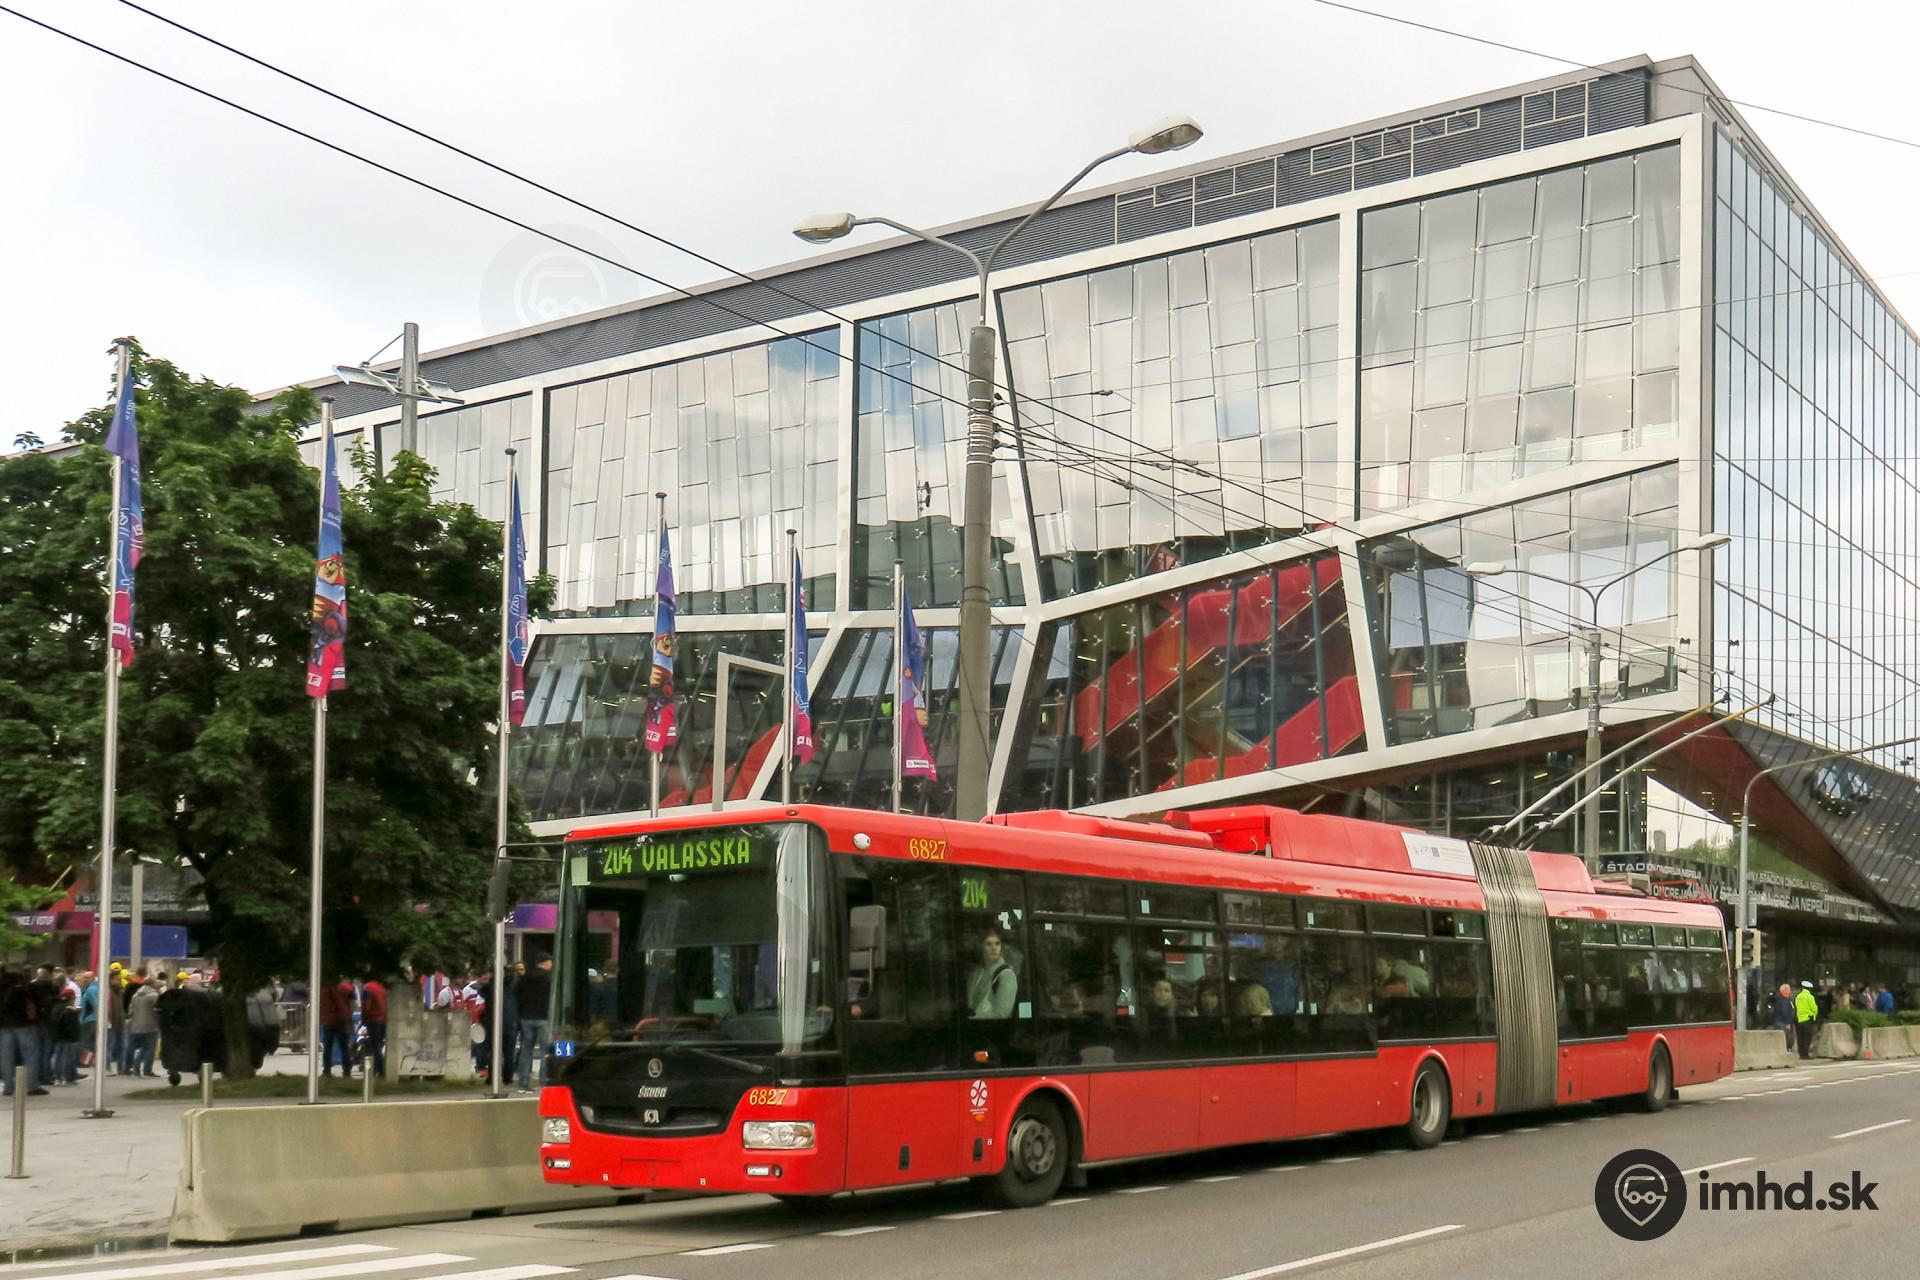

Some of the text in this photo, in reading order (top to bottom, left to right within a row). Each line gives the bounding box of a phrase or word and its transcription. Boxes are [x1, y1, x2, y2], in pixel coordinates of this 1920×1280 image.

[603, 837, 750, 874] 204 VALASSKA
[909, 838, 946, 860] 6827
[962, 879, 988, 909] 204
[749, 1089, 788, 1106] 6827
